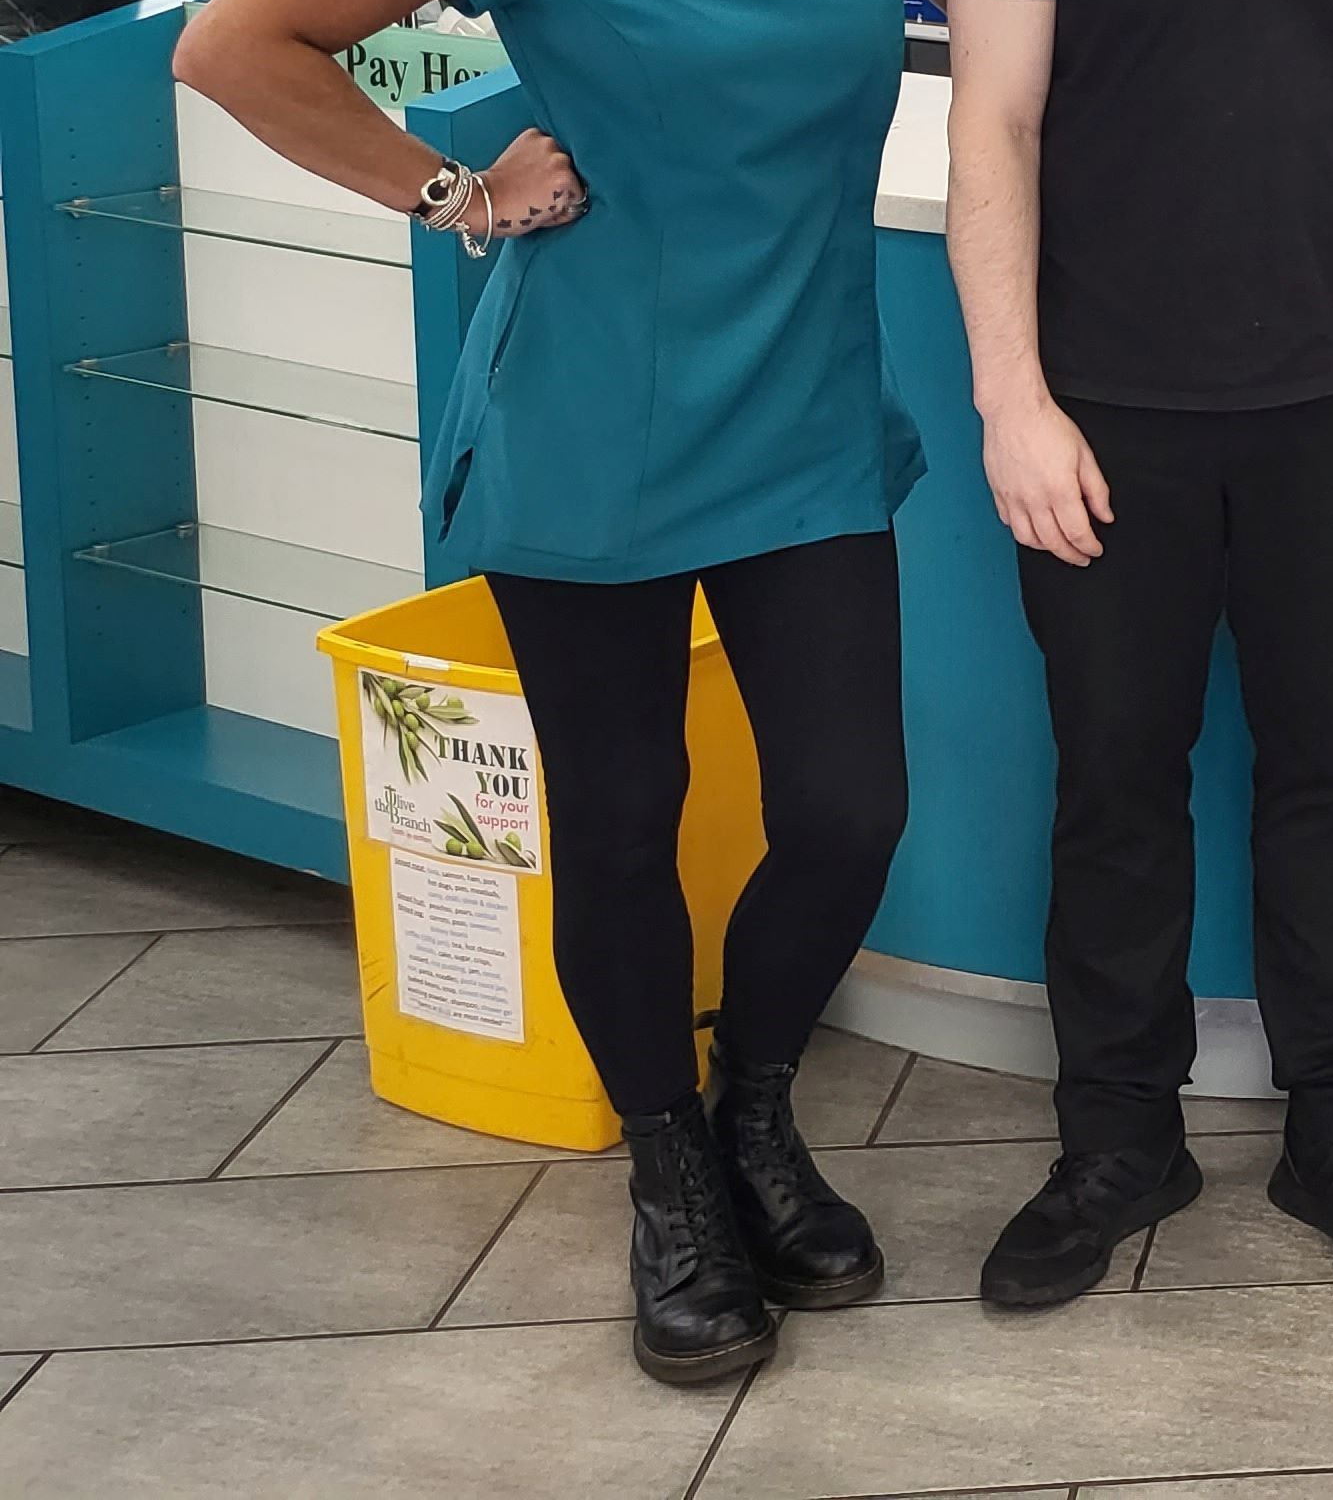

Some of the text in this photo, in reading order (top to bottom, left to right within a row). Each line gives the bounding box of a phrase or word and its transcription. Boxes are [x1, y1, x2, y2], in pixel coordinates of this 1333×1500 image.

[347, 43, 489, 102] Pay He
[434, 733, 528, 771] THANK
[475, 771, 530, 800] YOU
[476, 793, 529, 815] for your
[390, 806, 431, 833] Branch
[478, 814, 529, 831] support
